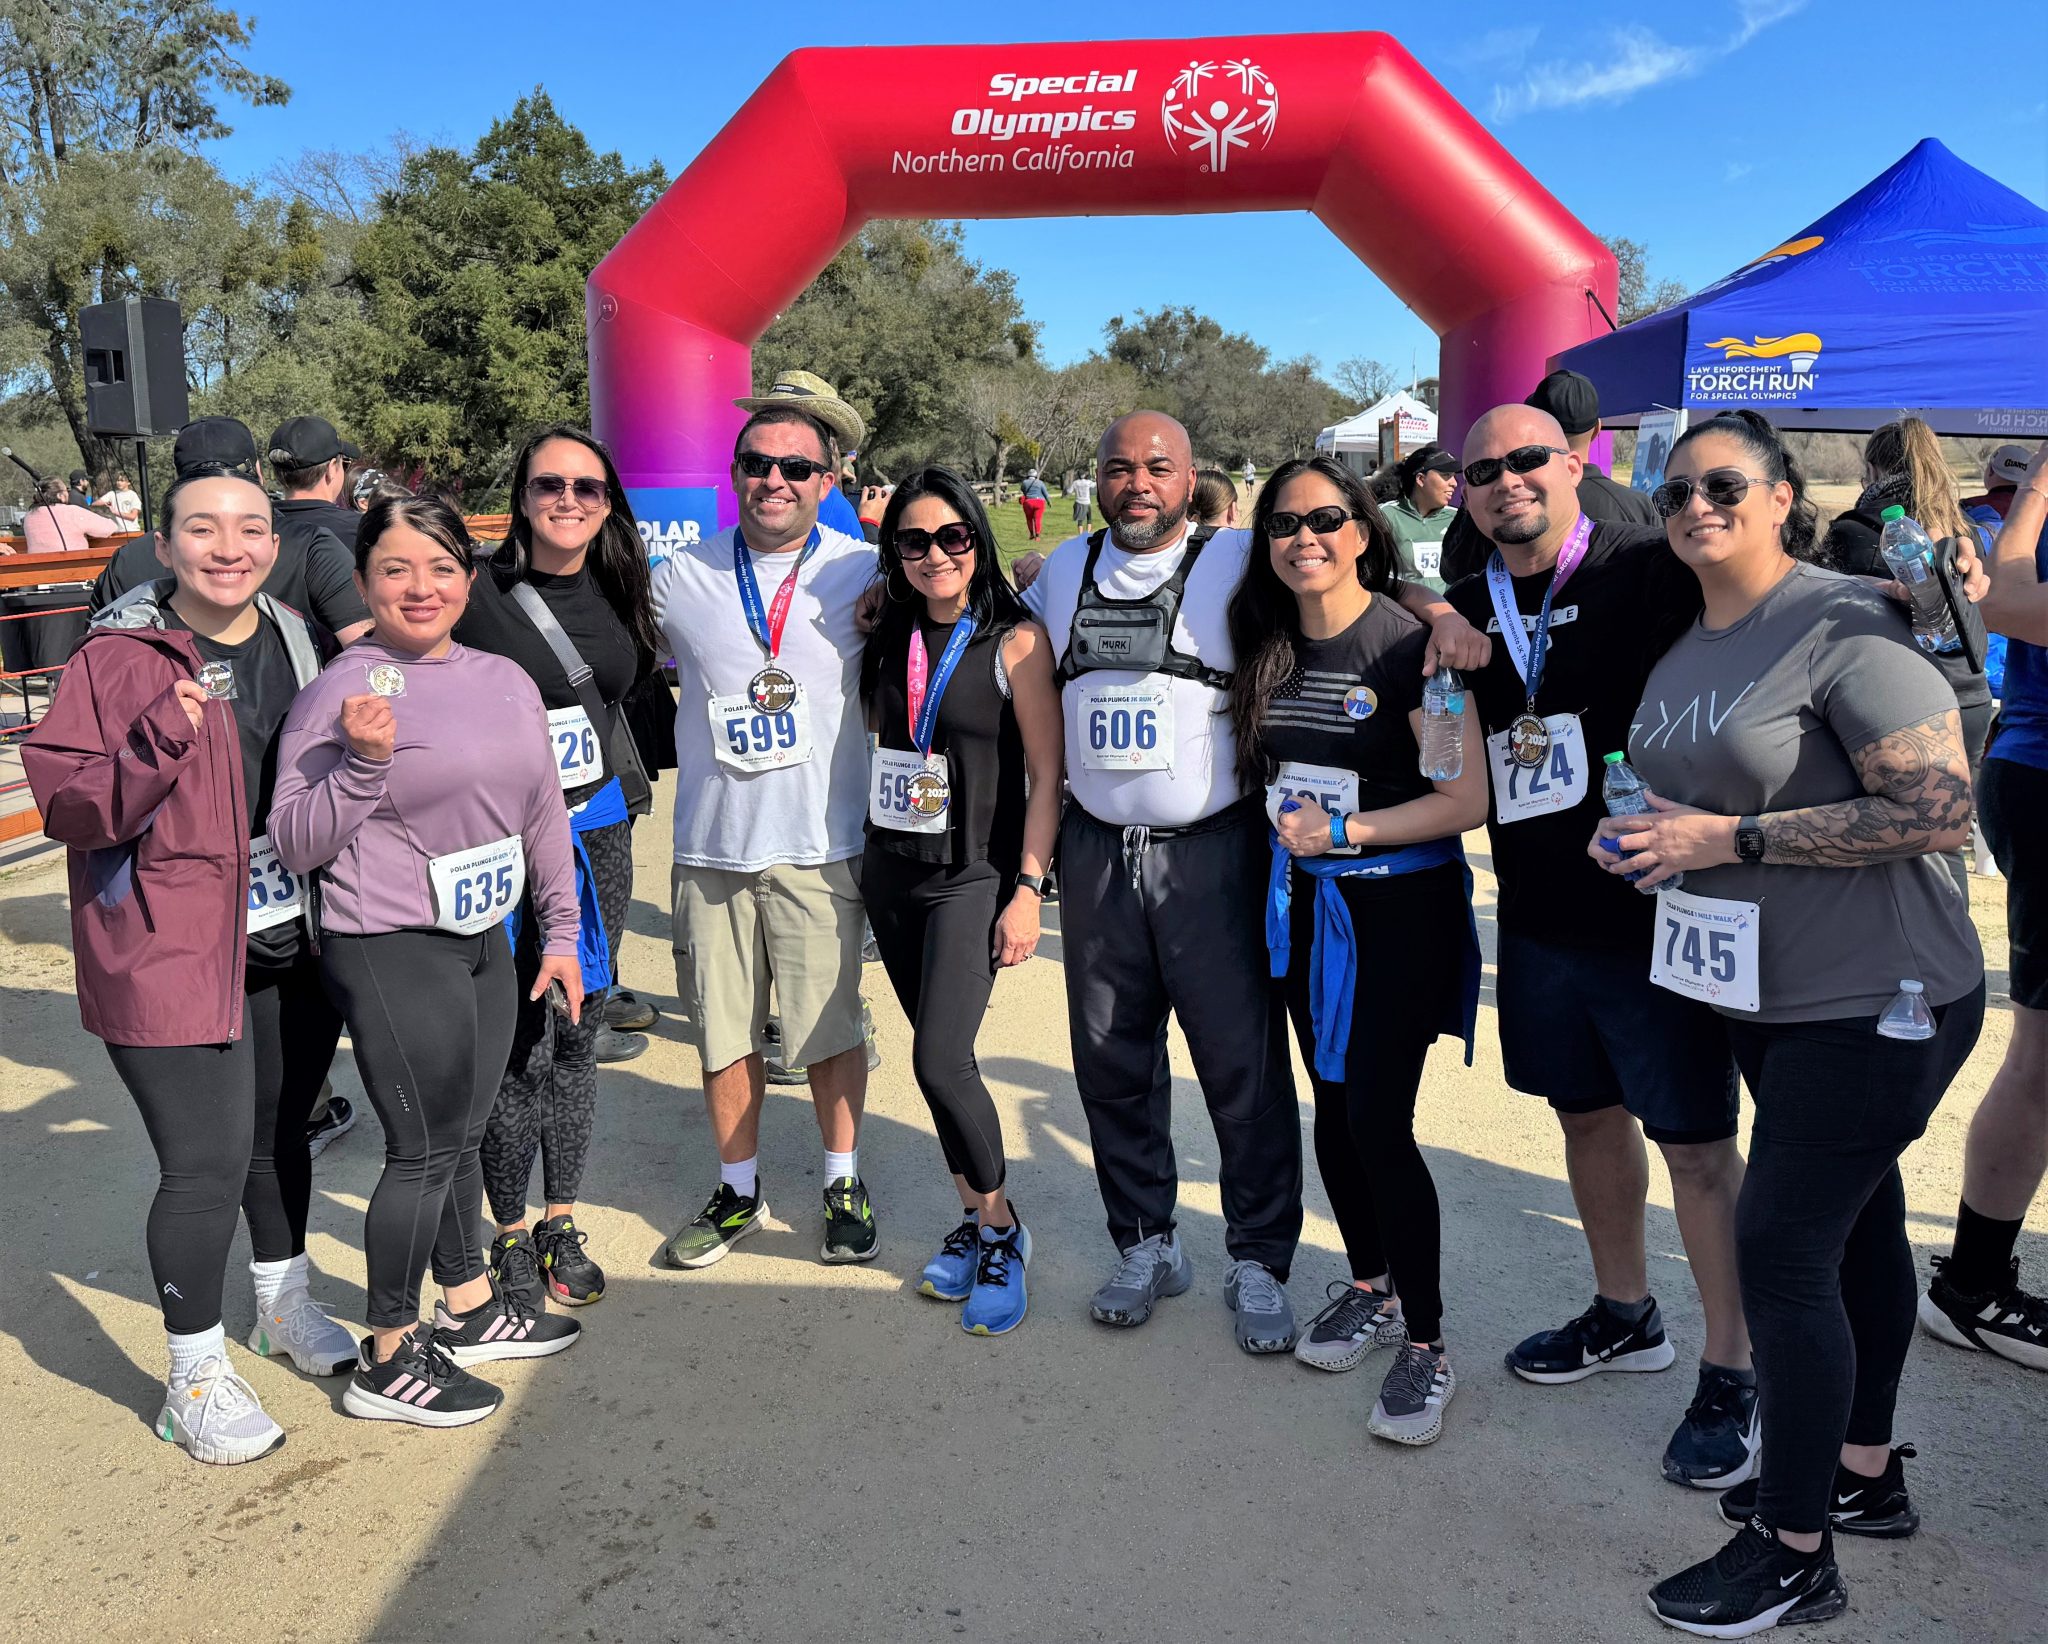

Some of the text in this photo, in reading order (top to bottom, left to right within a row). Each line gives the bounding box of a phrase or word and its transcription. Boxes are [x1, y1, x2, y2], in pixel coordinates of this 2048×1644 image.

[988, 69, 1138, 102] Special
[951, 104, 1137, 141] Olympics
[892, 143, 1135, 175] Northern California
[1687, 373, 1814, 391] TORCH RUN
[1691, 366, 1710, 374] LAW
[1690, 392, 1797, 400] FOR SPECIAL OLYMPICS
[635, 520, 701, 541] OLAR
[1503, 610, 1520, 645] Sacramento
[1101, 641, 1127, 649] MURK
[773, 684, 794, 694] 2025
[1347, 698, 1373, 715] VIP
[726, 711, 797, 755] 599
[1090, 709, 1156, 750] 606
[550, 727, 594, 770] 26
[1504, 742, 1575, 800] 724
[879, 772, 908, 812] 59
[927, 788, 948, 798] 2025
[450, 863, 470, 873] POLAR
[472, 857, 491, 869] PLUNGE
[248, 859, 295, 910] 63
[455, 864, 513, 921] 635
[1713, 915, 1733, 923] WALK
[1666, 917, 1736, 983] 745
